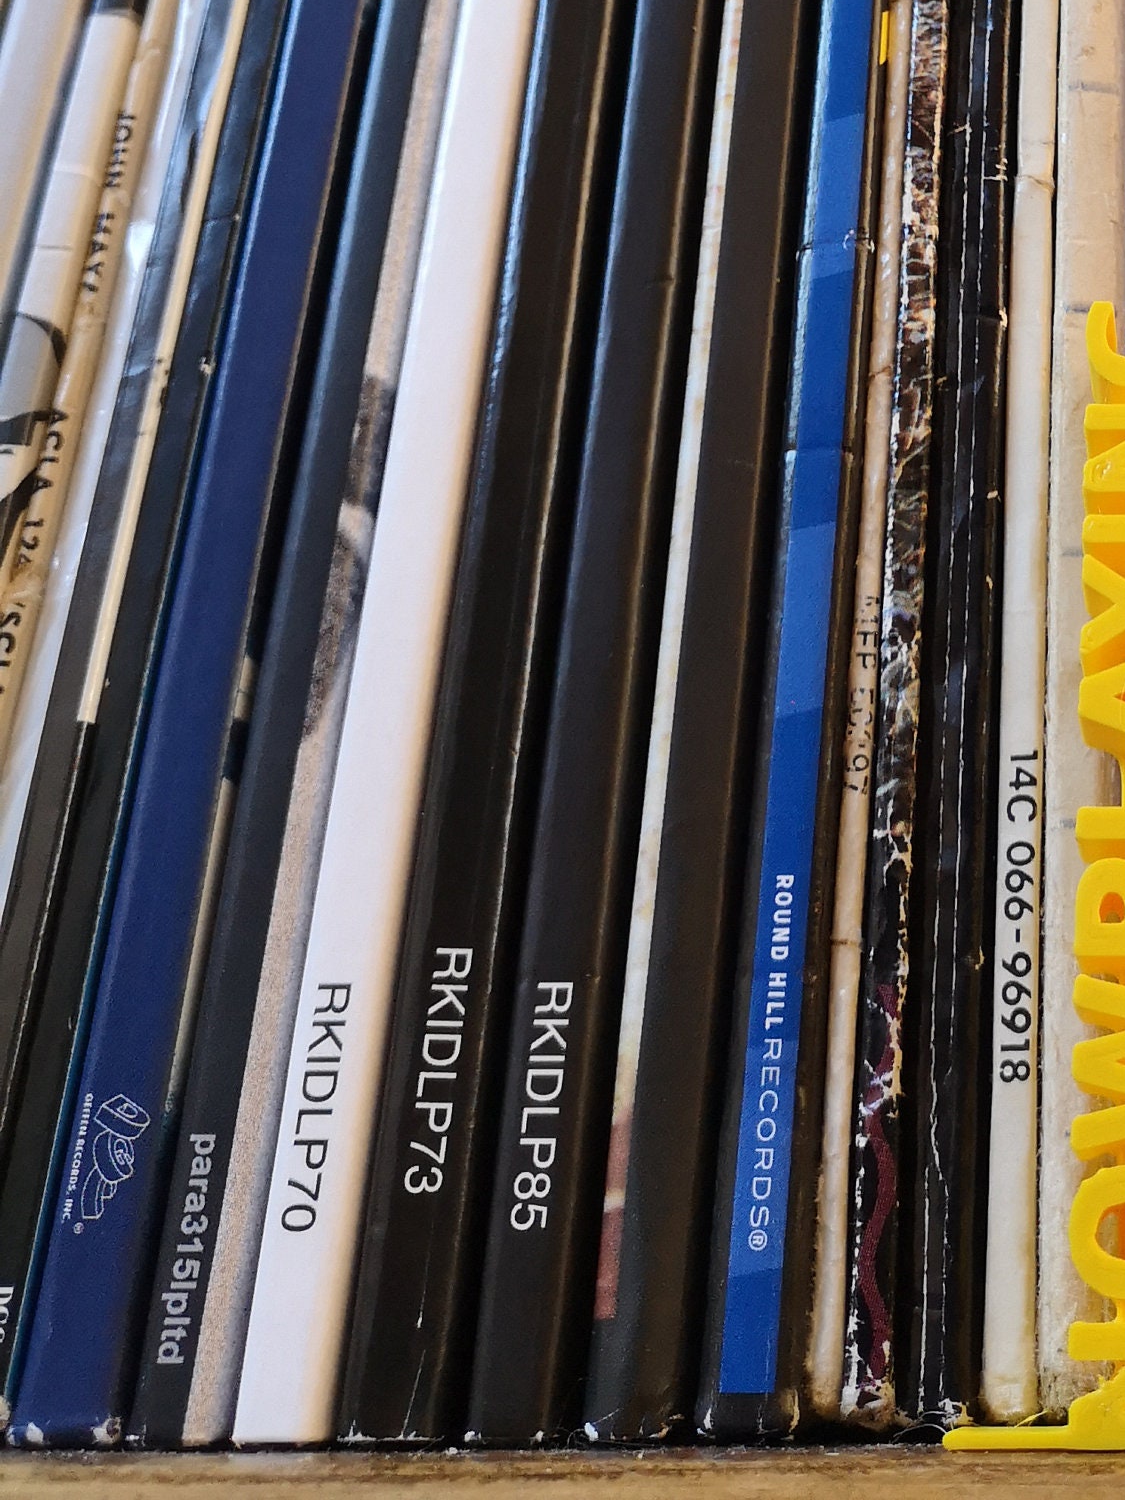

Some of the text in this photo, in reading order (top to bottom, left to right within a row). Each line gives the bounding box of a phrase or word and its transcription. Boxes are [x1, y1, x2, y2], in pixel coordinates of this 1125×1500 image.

[763, 971, 787, 1031] HILL
[768, 873, 794, 962] ROUND
[997, 749, 1039, 1084] 14C 066-96918
[65, 1137, 86, 1196] RECORDS,
[278, 979, 352, 1236] RKIDLP70
[401, 942, 474, 1198] RKIDLP73
[507, 978, 575, 1234] RKIDLP85
[59, 1196, 74, 1225] INC.
[149, 1128, 222, 1370] para315lpltd
